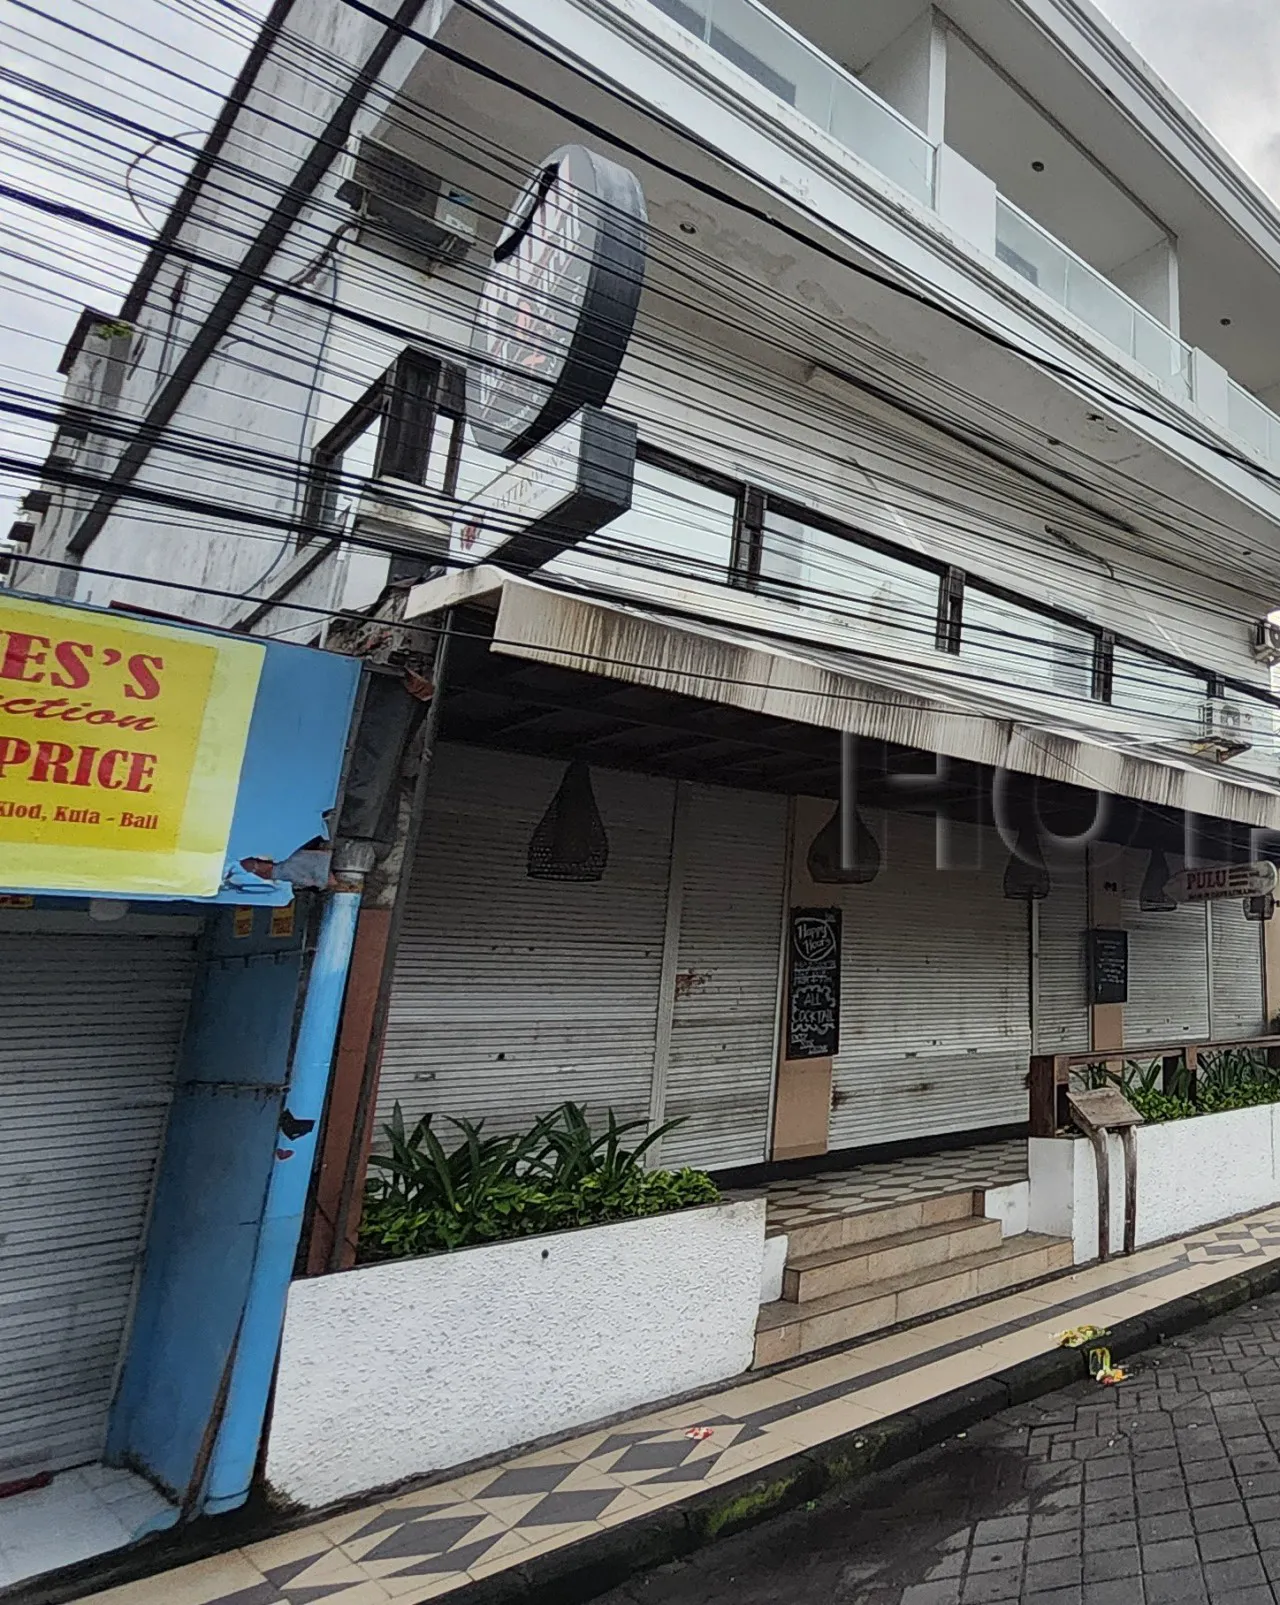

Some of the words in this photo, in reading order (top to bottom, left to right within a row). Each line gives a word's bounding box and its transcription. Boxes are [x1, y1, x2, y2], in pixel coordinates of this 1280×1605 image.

[0, 630, 164, 700] ES'S
[0, 696, 158, 731] ction
[0, 736, 157, 793] PRICE
[53, 806, 100, 825] Kuta
[797, 924, 828, 939] Happy
